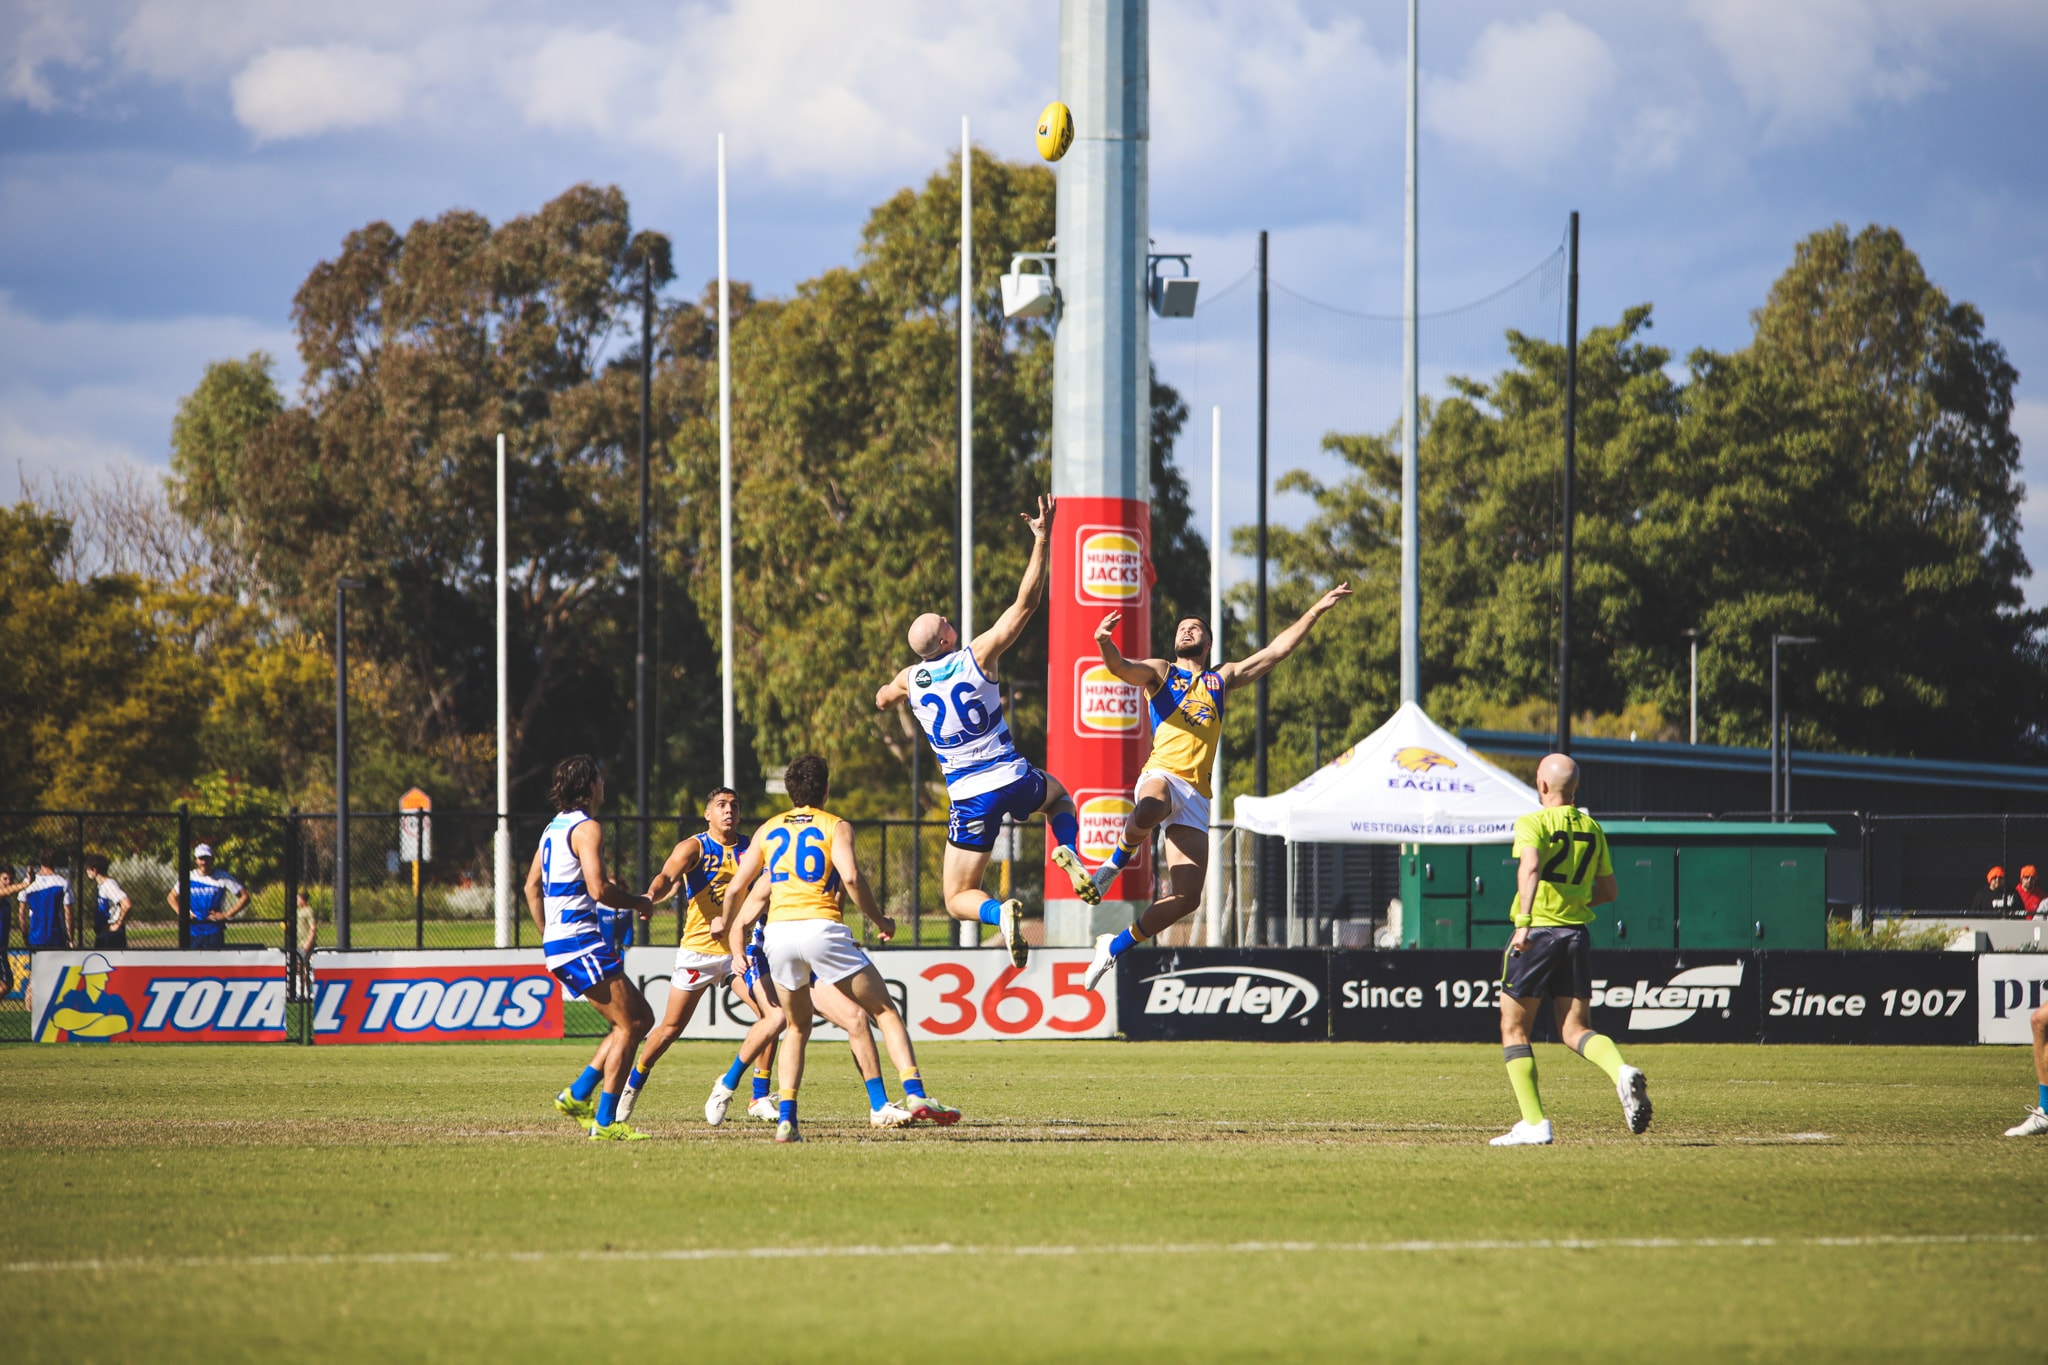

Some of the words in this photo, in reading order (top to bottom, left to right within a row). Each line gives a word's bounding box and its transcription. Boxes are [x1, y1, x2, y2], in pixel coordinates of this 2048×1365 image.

[1087, 553, 1138, 565] HUNGRY
[1085, 685, 1137, 697] HUNGRY
[919, 682, 990, 747] 26
[1388, 778, 1476, 793] EAGLES
[1083, 817, 1127, 828] HUNG
[765, 826, 826, 884] 26
[1540, 830, 1597, 886] 27
[363, 978, 551, 1029] TOOLS
[1143, 976, 1300, 1024] Burley
[1341, 979, 1423, 1009] Since
[1768, 987, 1867, 1017] Since
[1880, 988, 1967, 1017] 1907
